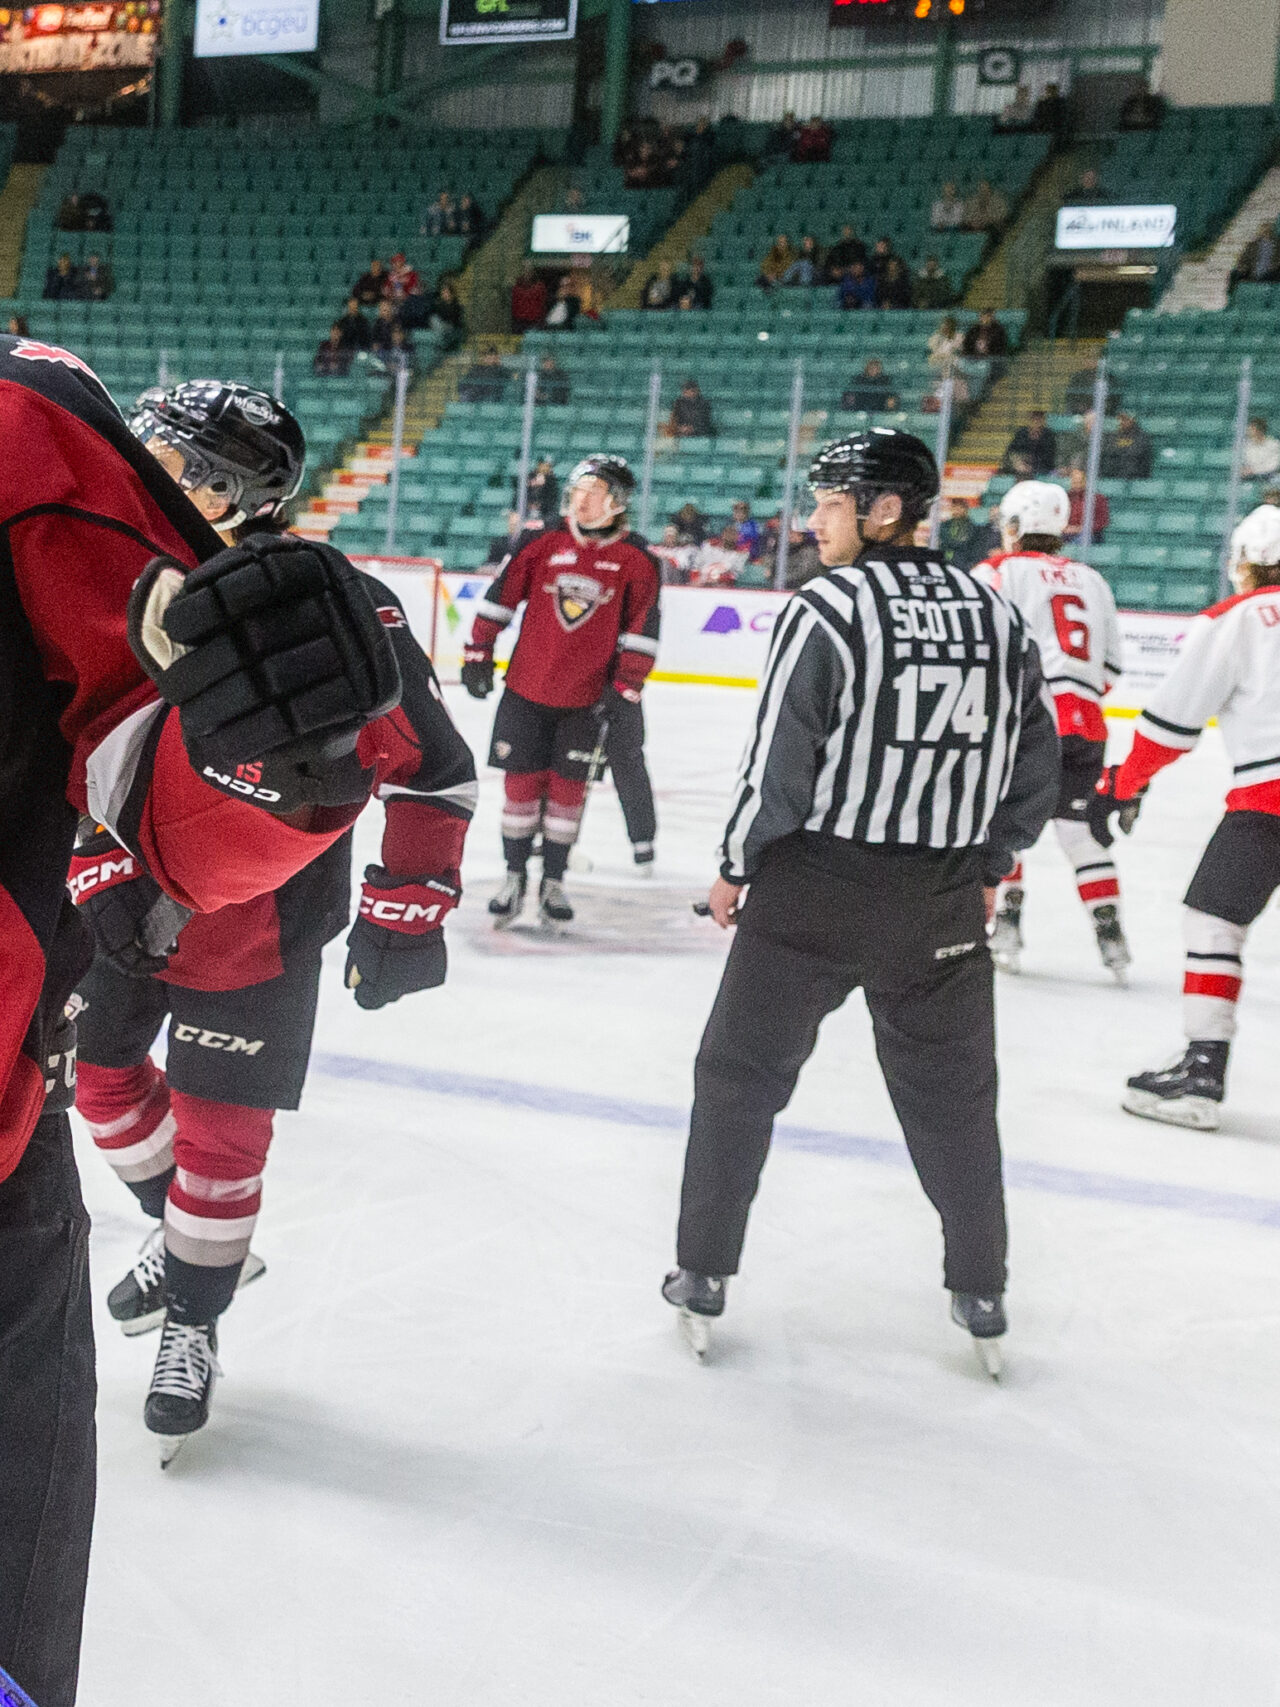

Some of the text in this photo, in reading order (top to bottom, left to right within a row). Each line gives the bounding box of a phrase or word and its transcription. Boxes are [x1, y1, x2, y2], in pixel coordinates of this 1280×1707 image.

[891, 599, 985, 642] SCOTT
[1050, 594, 1090, 661] 6
[893, 664, 989, 743] 174
[203, 766, 282, 802] CCM
[175, 1023, 265, 1056] CCM
